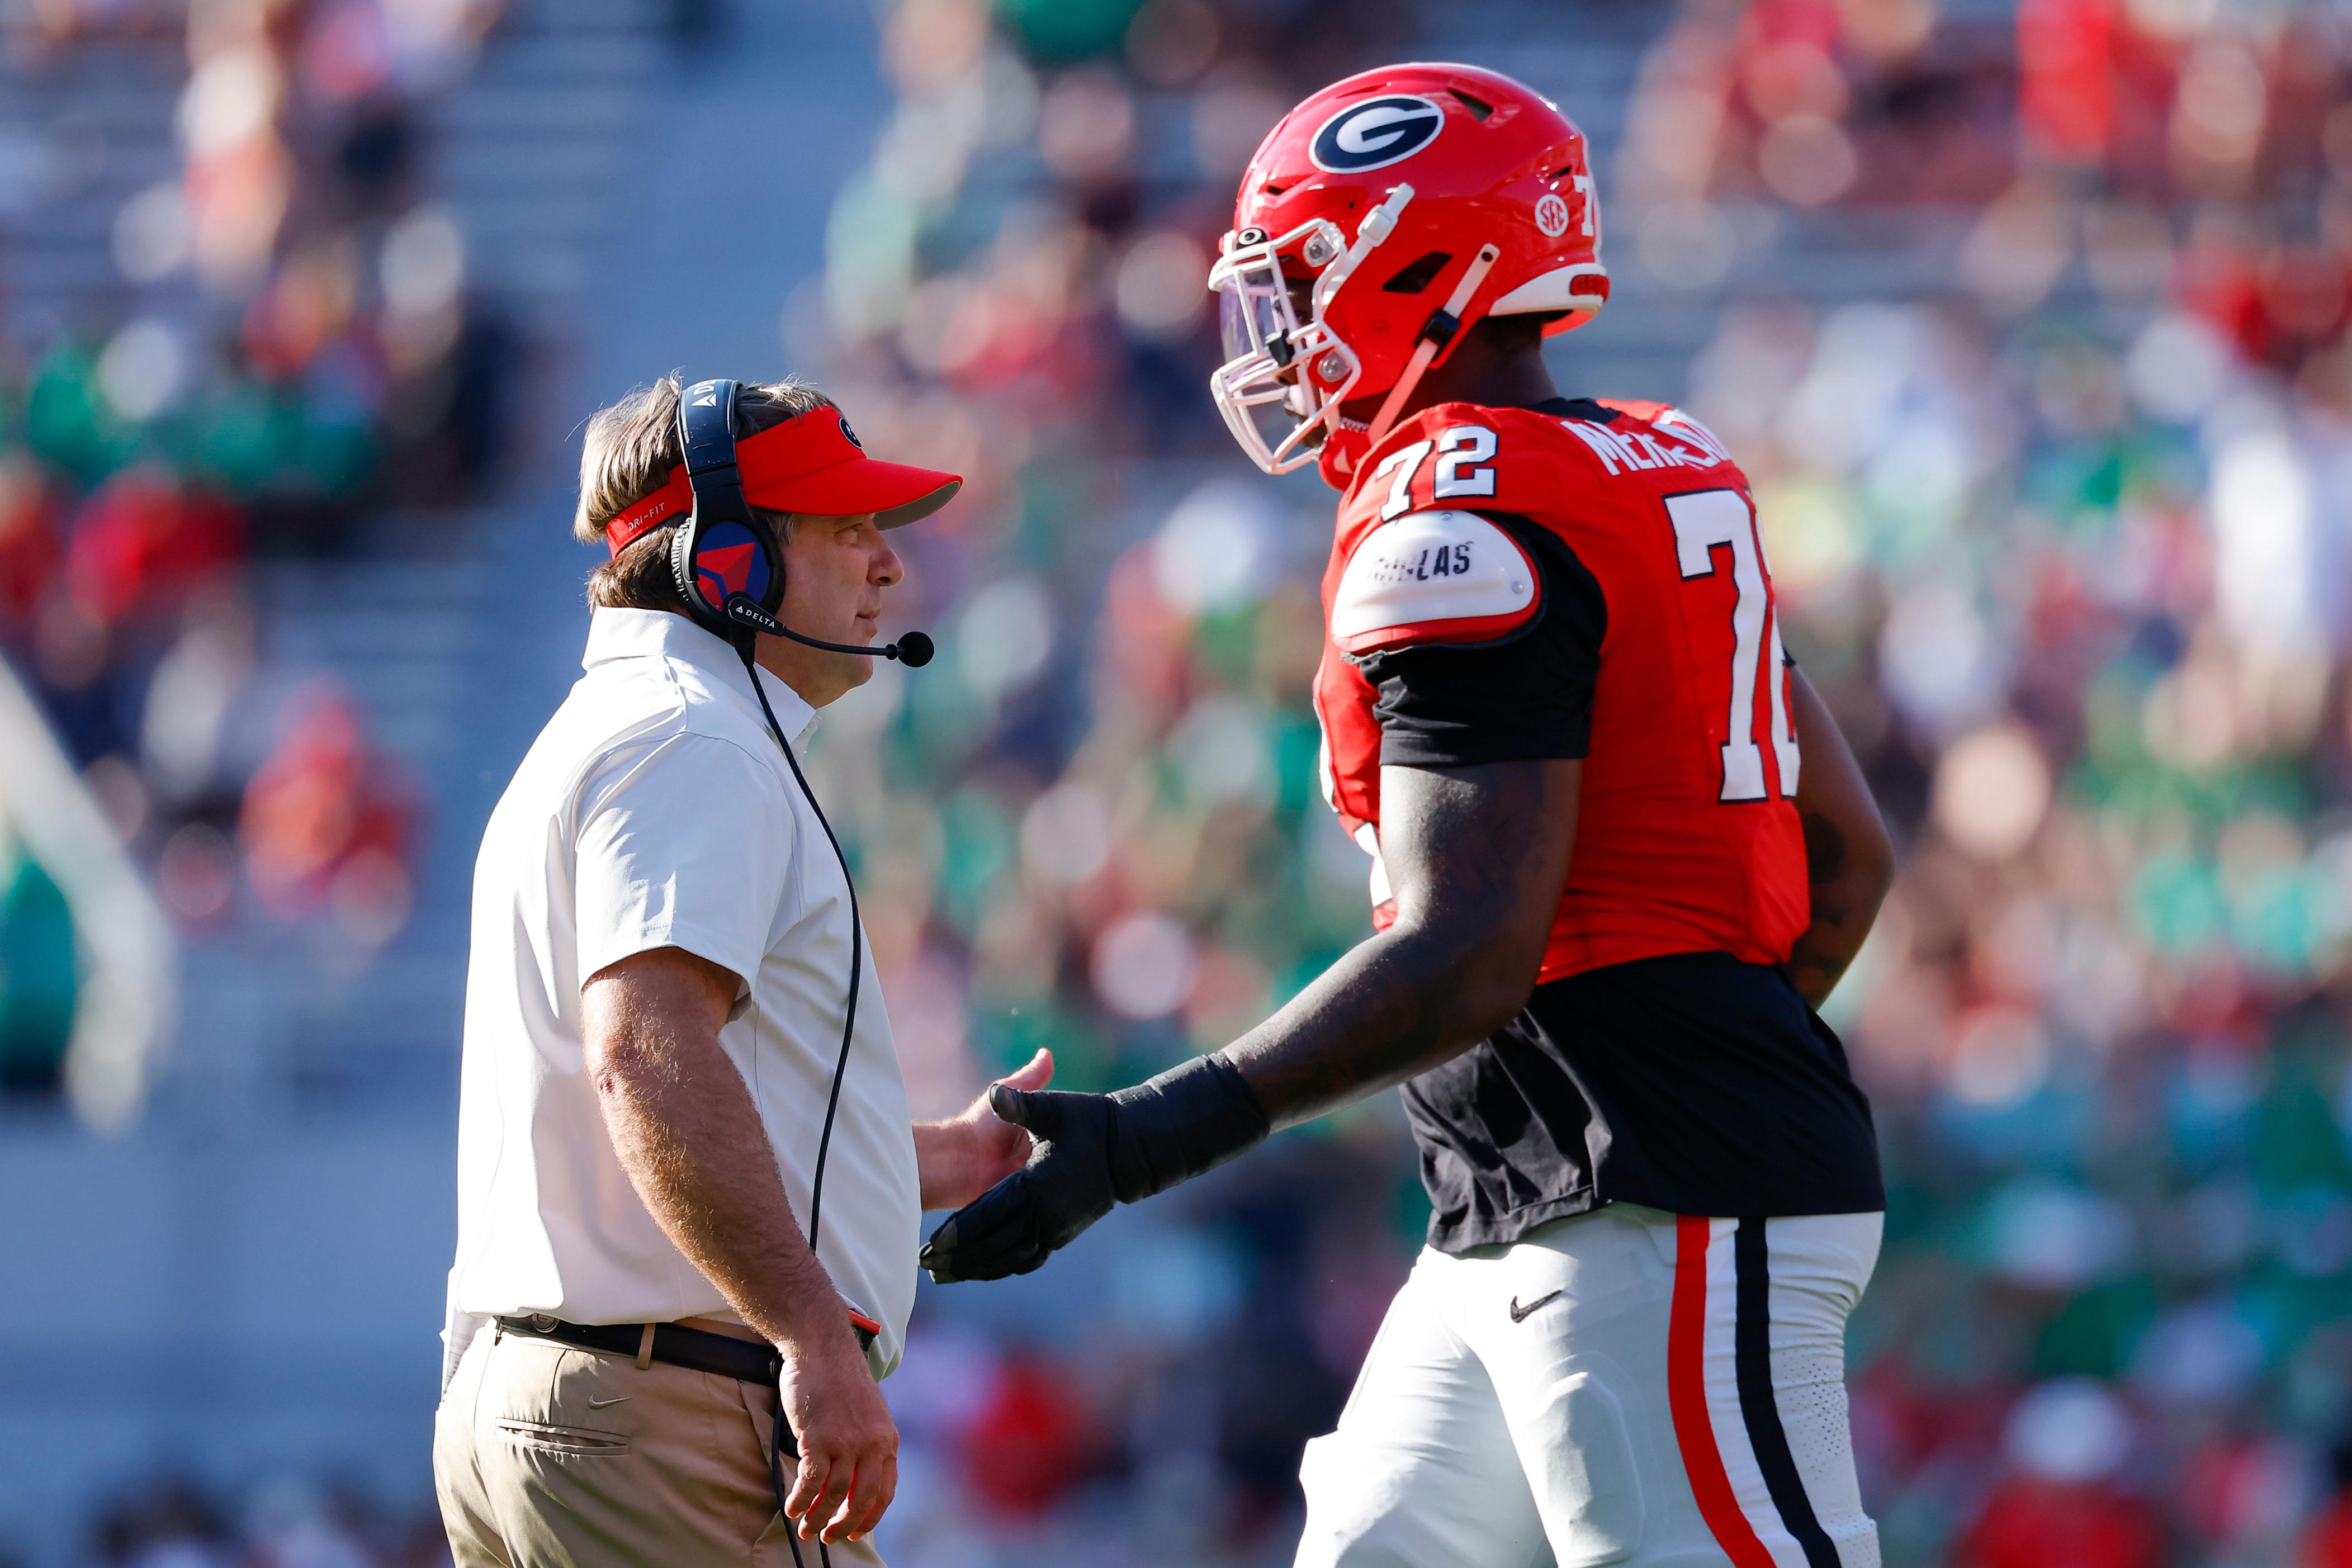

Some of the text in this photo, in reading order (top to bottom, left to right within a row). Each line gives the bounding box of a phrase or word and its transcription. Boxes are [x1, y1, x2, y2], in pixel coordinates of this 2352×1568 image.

[1336, 106, 1440, 154] G
[1538, 198, 1566, 234] SEC
[1376, 425, 1498, 524] 72
[628, 502, 665, 532] DRI-FIT
[745, 609, 775, 628] DELTA
